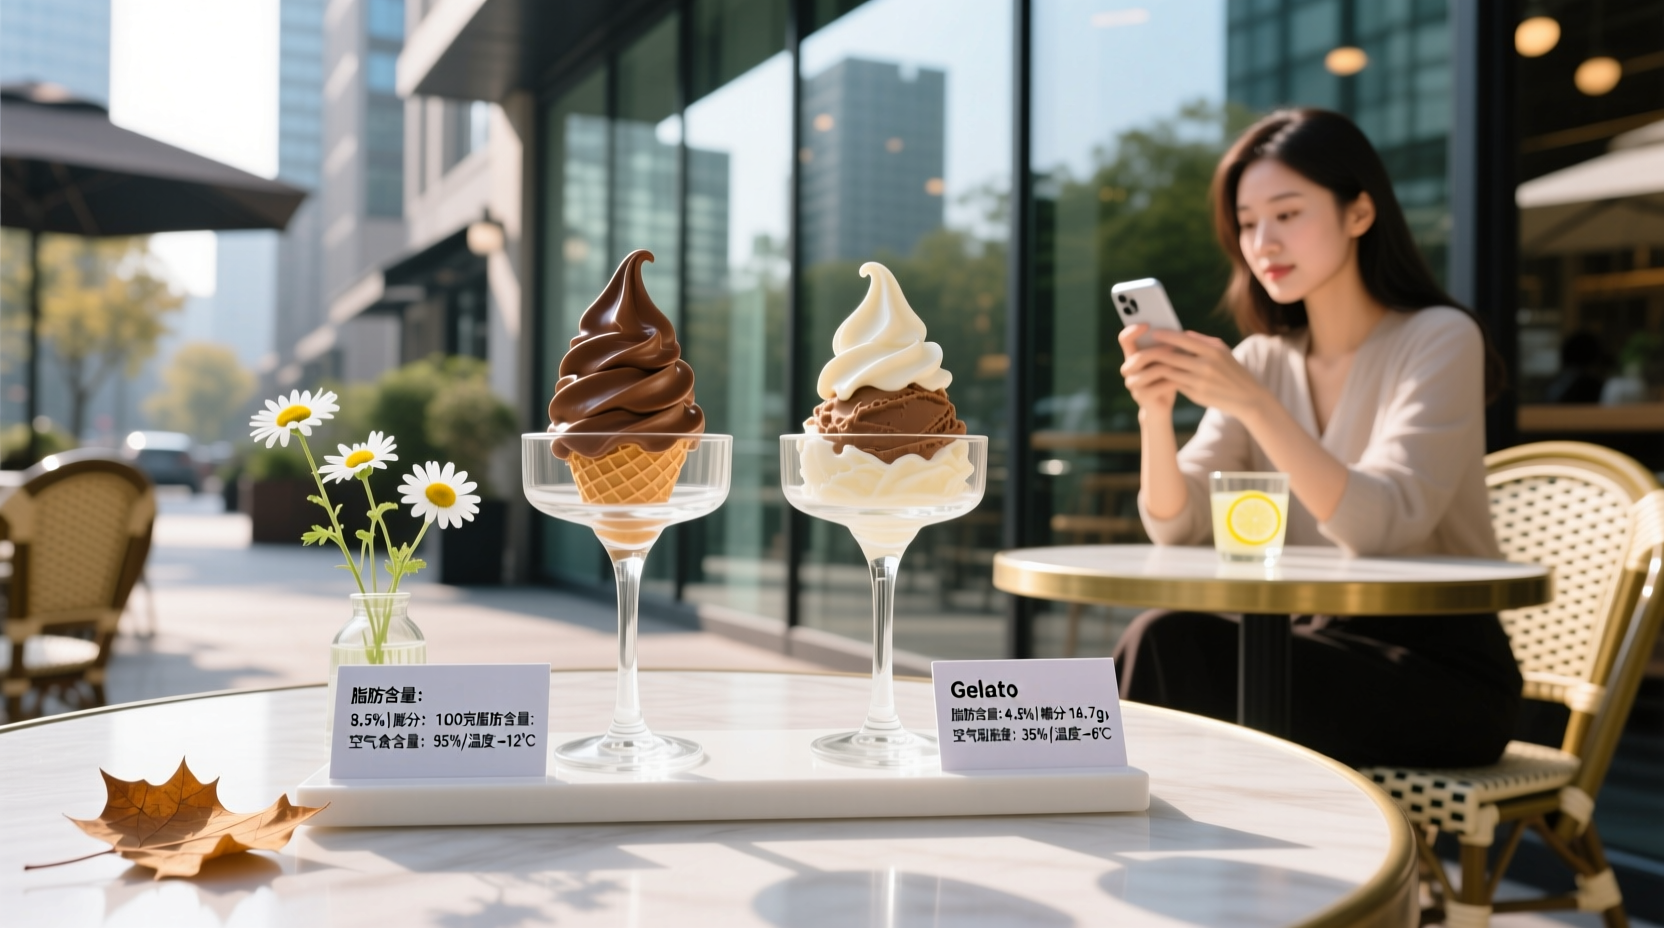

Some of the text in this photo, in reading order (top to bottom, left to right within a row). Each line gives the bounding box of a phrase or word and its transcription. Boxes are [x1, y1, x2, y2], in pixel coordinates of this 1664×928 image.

[351, 686, 423, 705] 脂肪含量:
[950, 680, 1019, 699] Gelato
